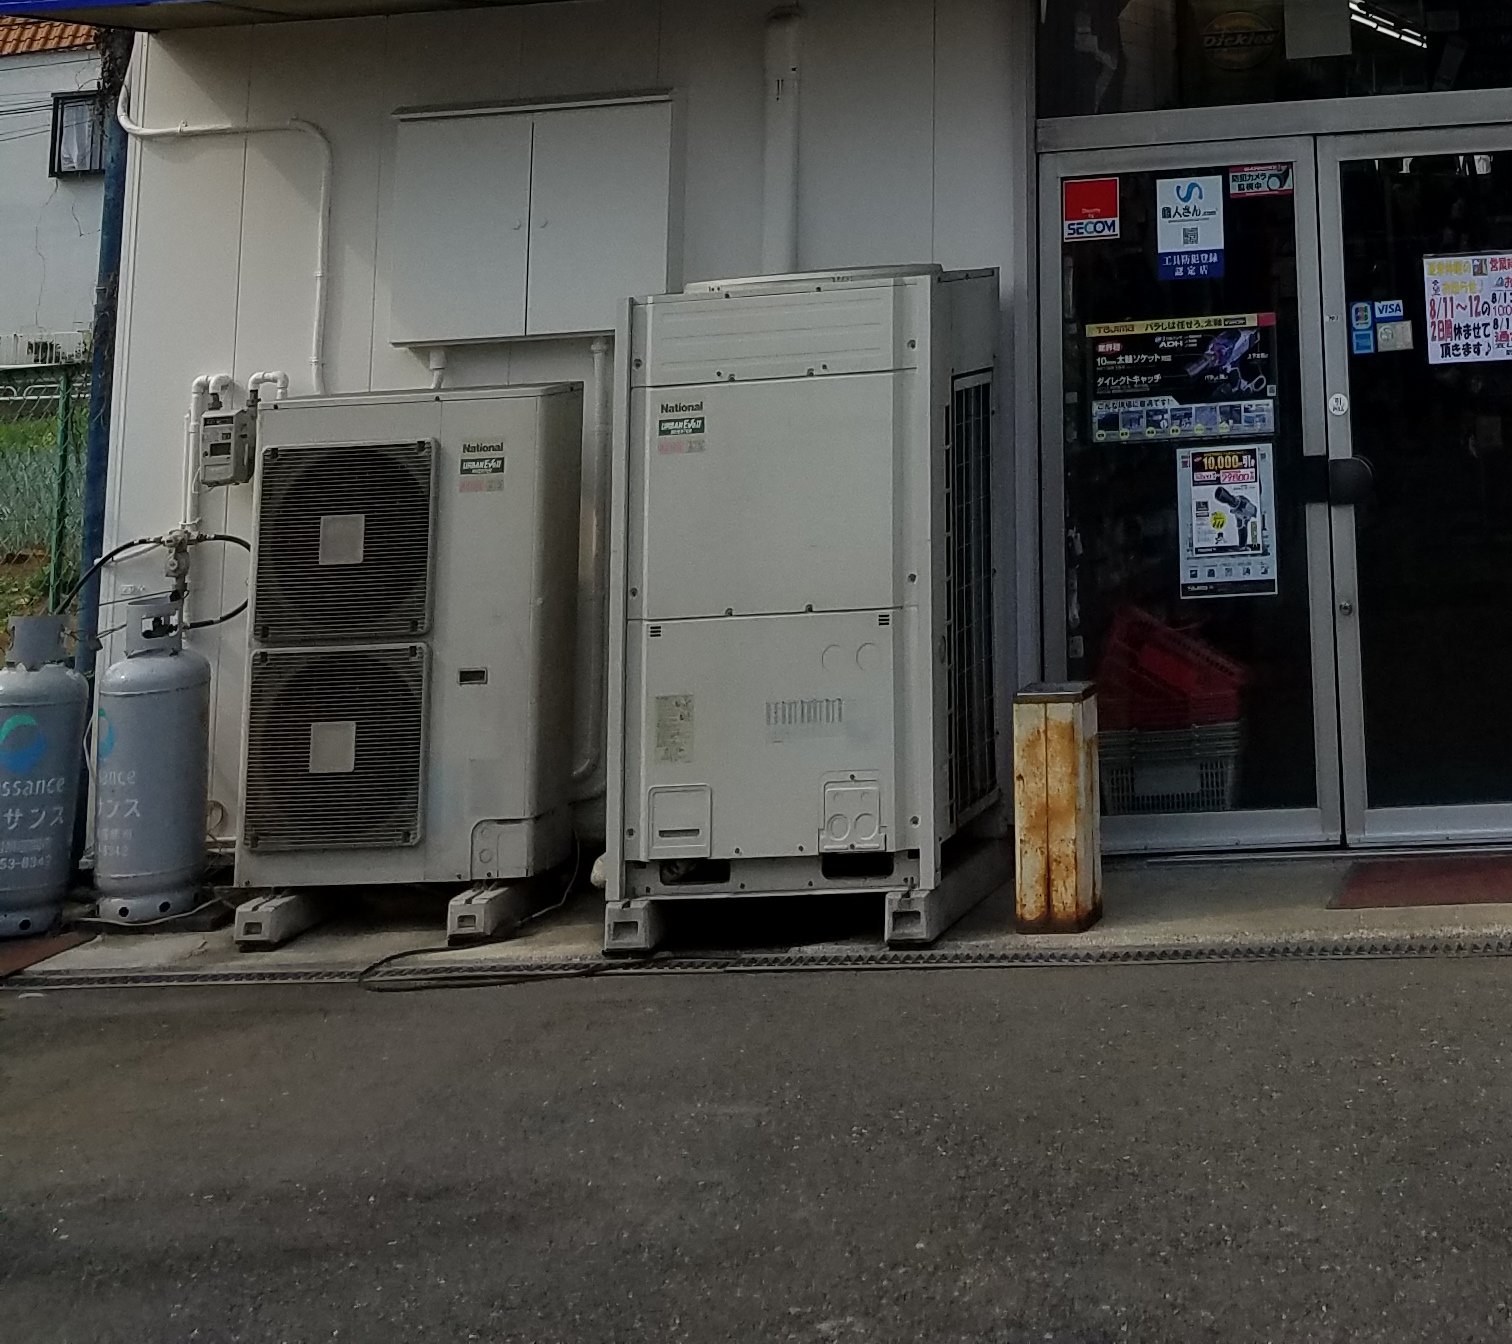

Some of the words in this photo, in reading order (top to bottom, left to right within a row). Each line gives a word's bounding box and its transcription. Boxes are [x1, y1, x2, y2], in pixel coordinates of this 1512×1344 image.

[1231, 172, 1267, 183] 防犯カメラ
[1067, 219, 1116, 235] SECOM
[1377, 303, 1402, 314] VISA
[660, 401, 703, 413] National
[462, 441, 504, 453] National
